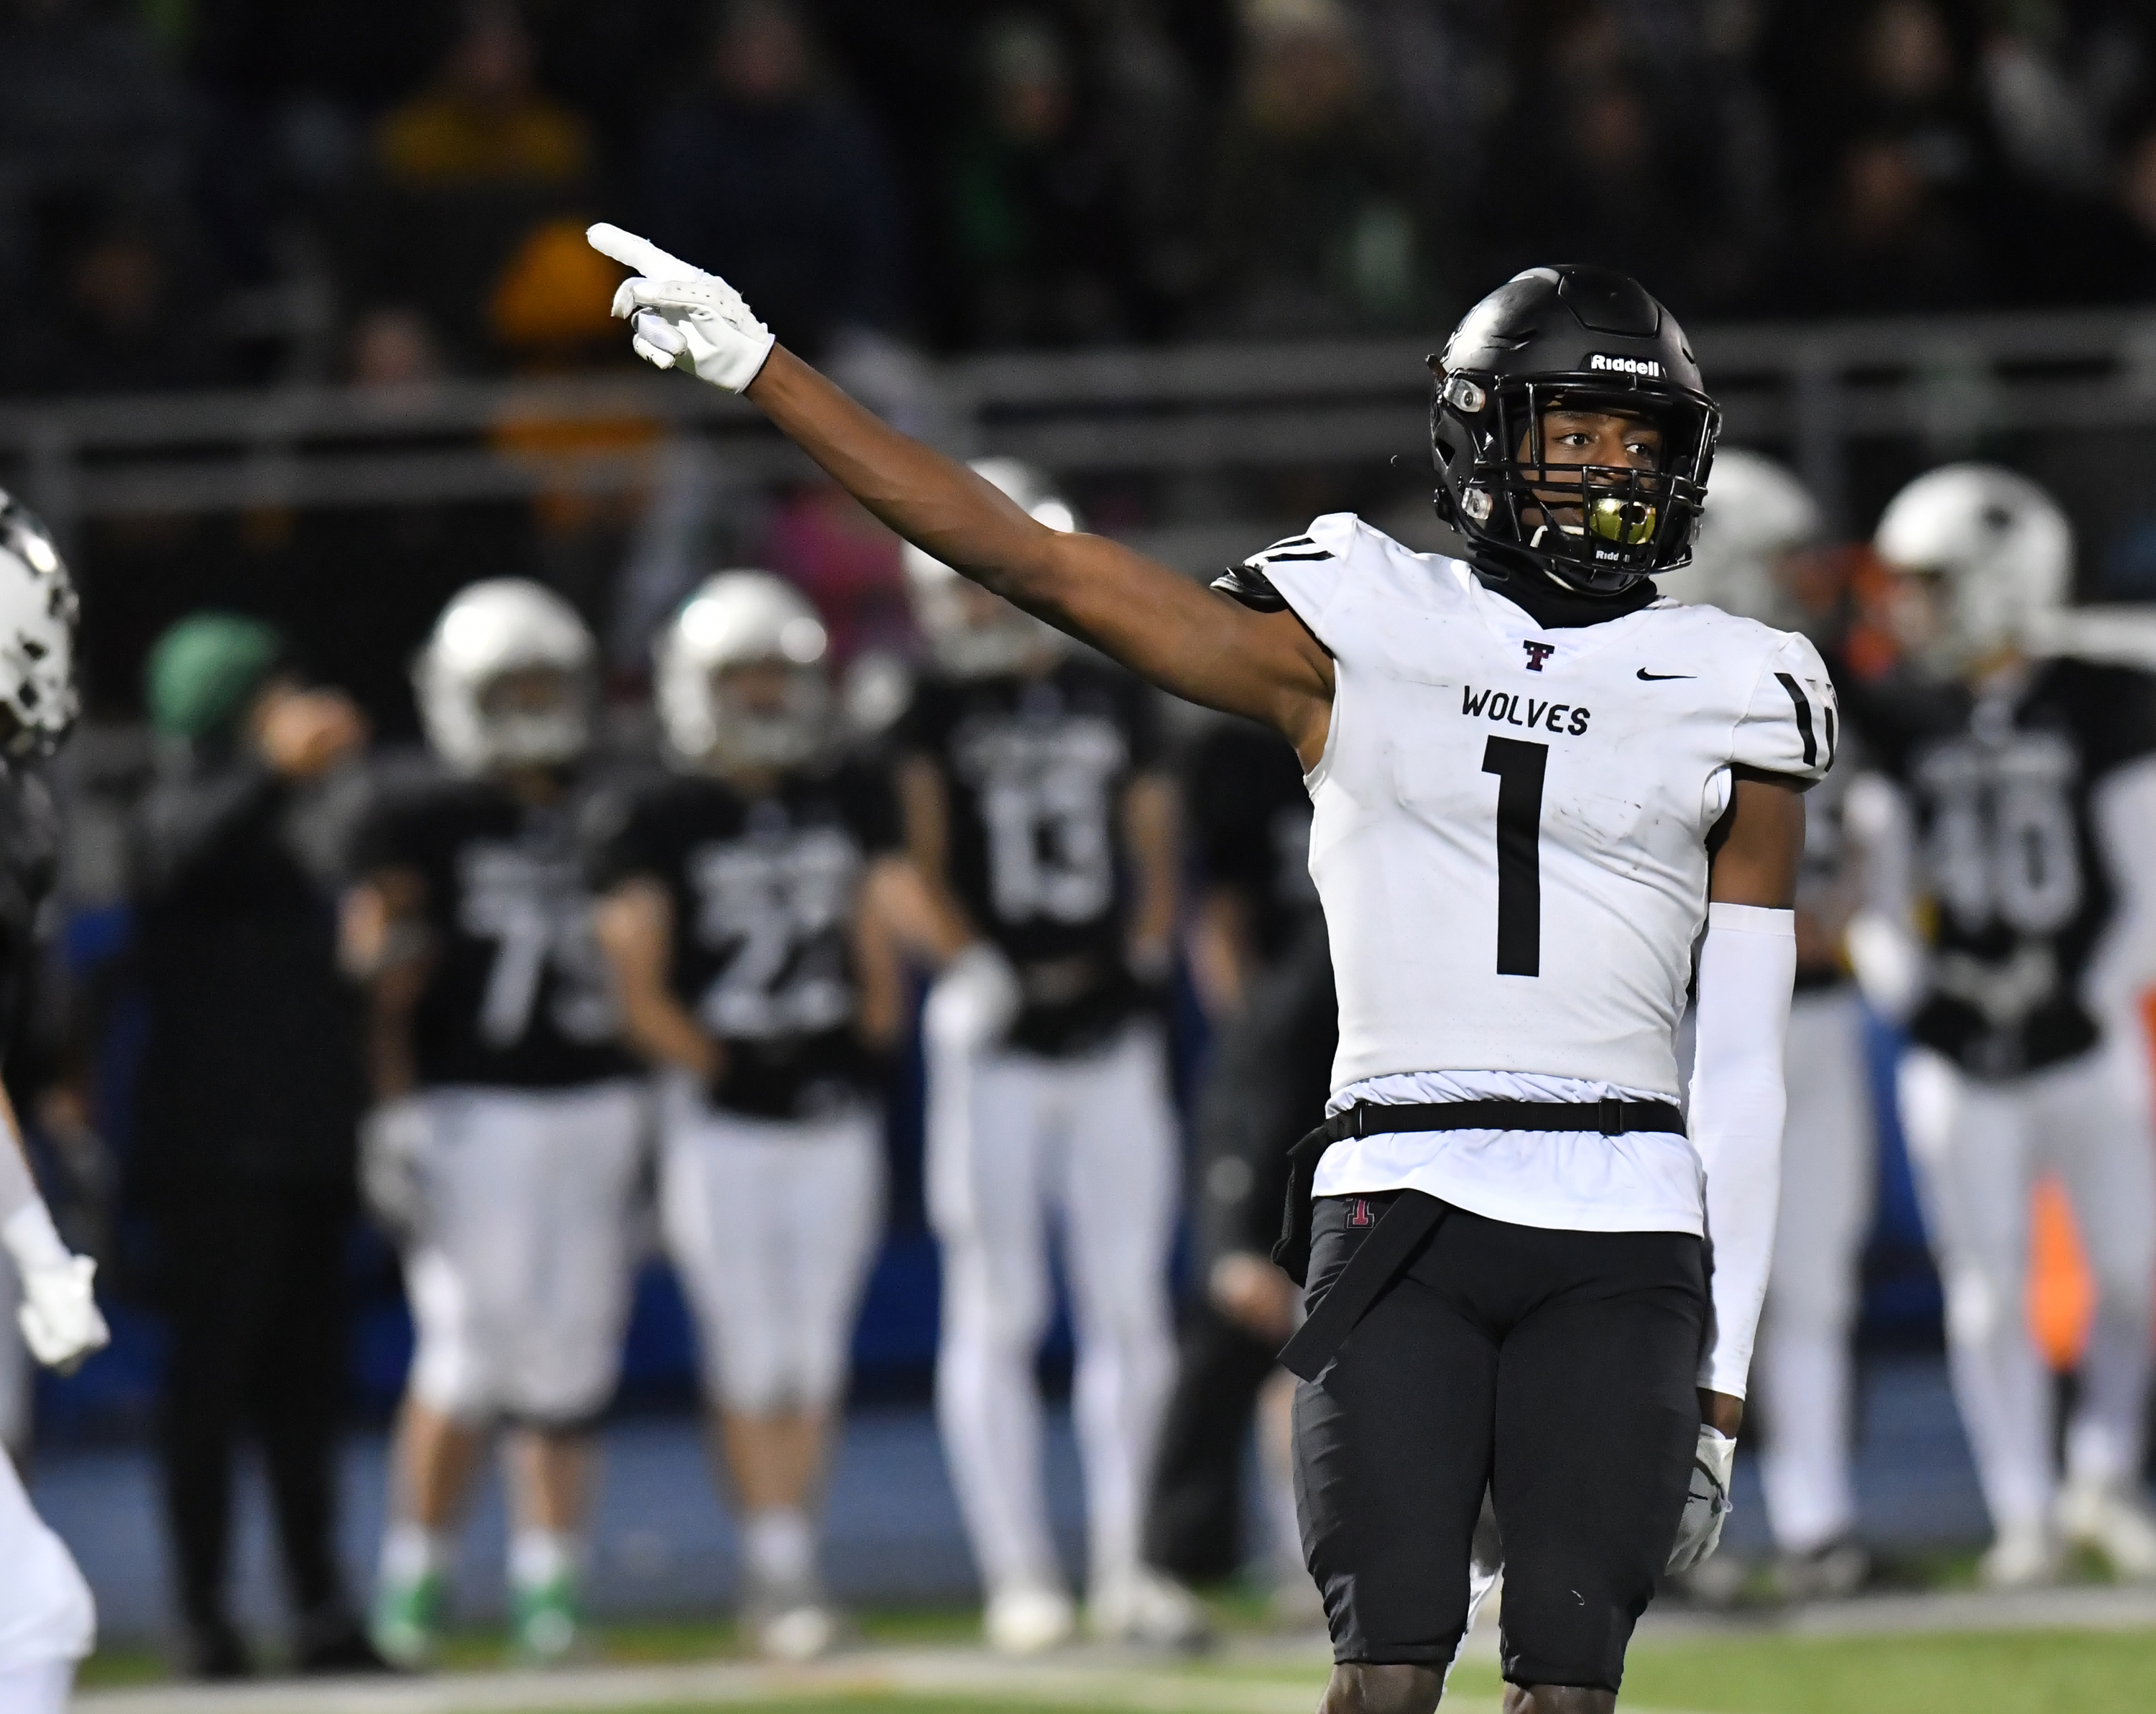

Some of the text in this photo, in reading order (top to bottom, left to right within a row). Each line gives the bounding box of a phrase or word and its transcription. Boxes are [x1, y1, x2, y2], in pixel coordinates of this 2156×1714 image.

[1590, 354, 1659, 377] Riddell
[1595, 550, 1631, 563] Riddll
[1522, 639, 1556, 672] T
[1462, 685, 1591, 737] WOLVES
[1480, 734, 1549, 978] 1
